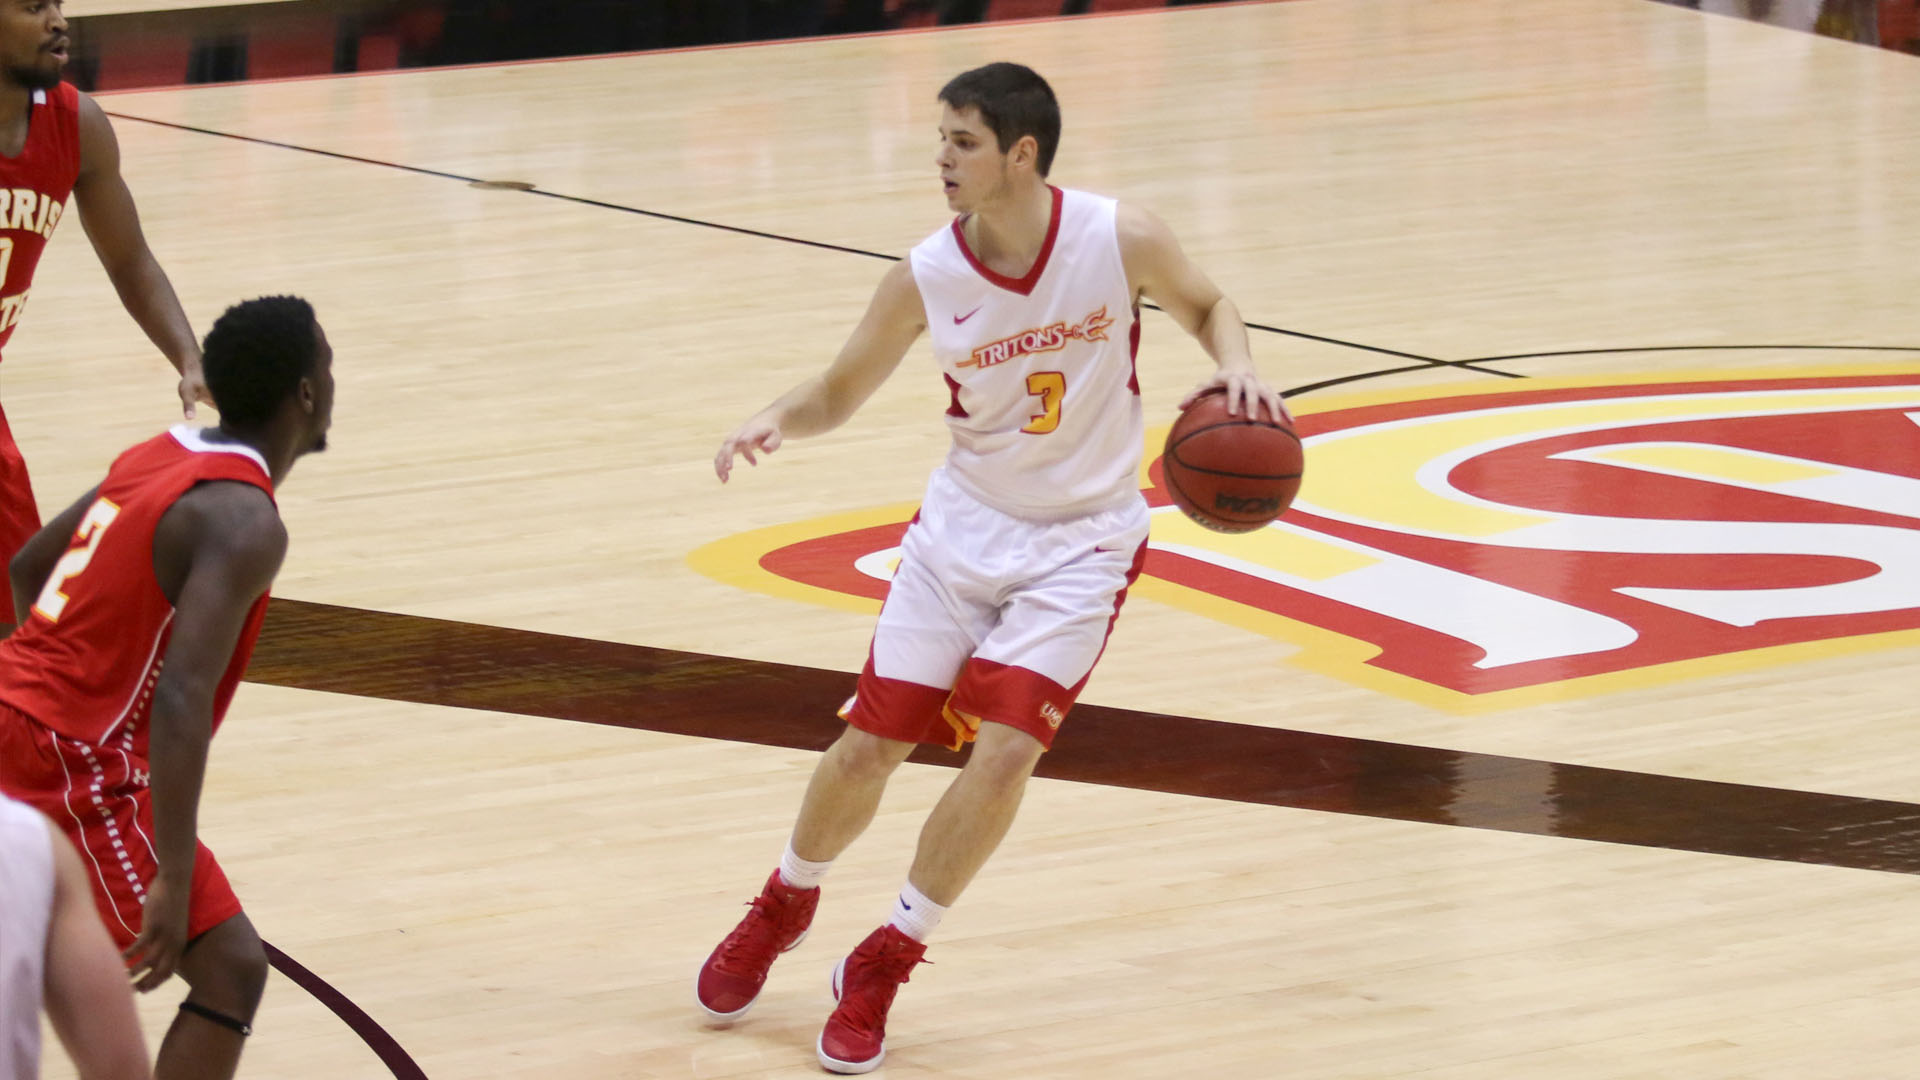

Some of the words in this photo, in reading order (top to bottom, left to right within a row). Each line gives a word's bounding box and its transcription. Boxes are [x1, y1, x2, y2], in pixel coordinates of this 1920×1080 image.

[973, 323, 1065, 367] TRITONS
[1020, 371, 1066, 434] 3
[33, 496, 121, 623] 2
